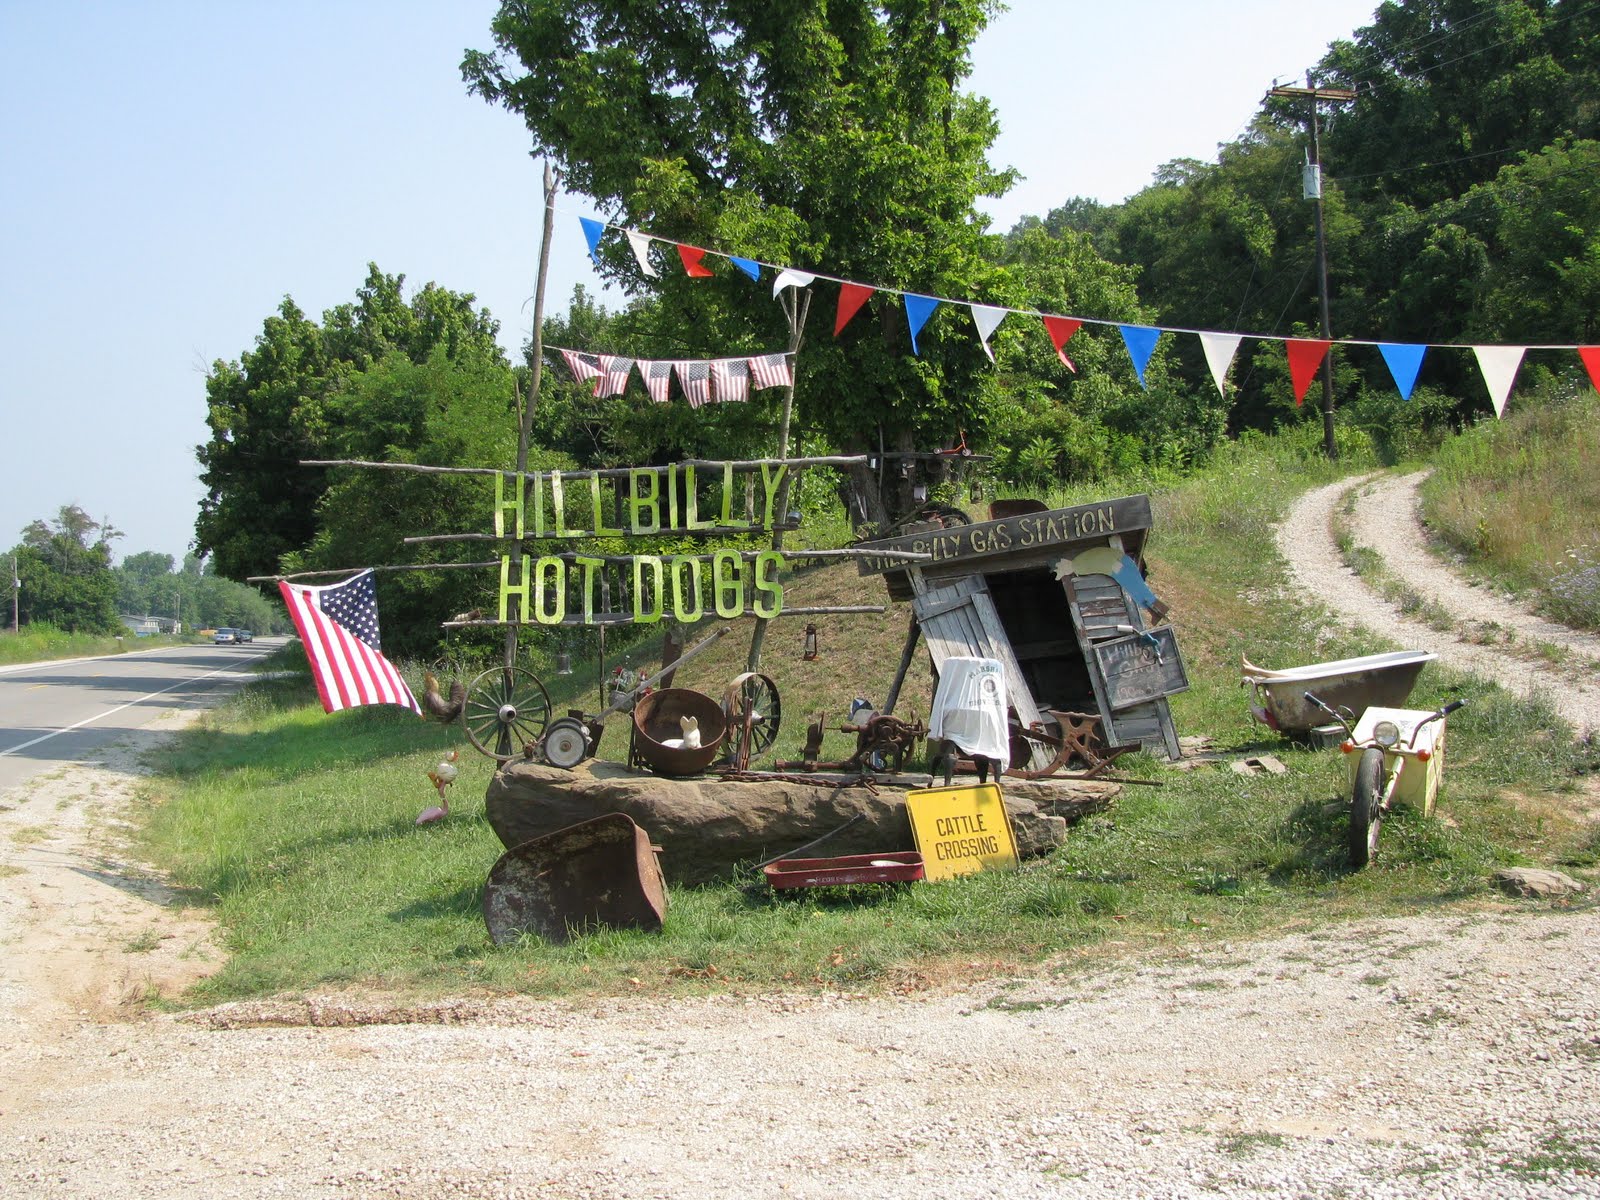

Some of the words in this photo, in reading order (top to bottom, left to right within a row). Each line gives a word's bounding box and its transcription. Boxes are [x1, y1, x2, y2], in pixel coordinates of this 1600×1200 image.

[495, 462, 788, 540] HILLBILLY
[969, 523, 1012, 553] GAS
[499, 554, 605, 625] HOT
[633, 549, 785, 623] DOGS
[936, 814, 988, 837] CATTLE
[935, 836, 999, 861] CROSSING
